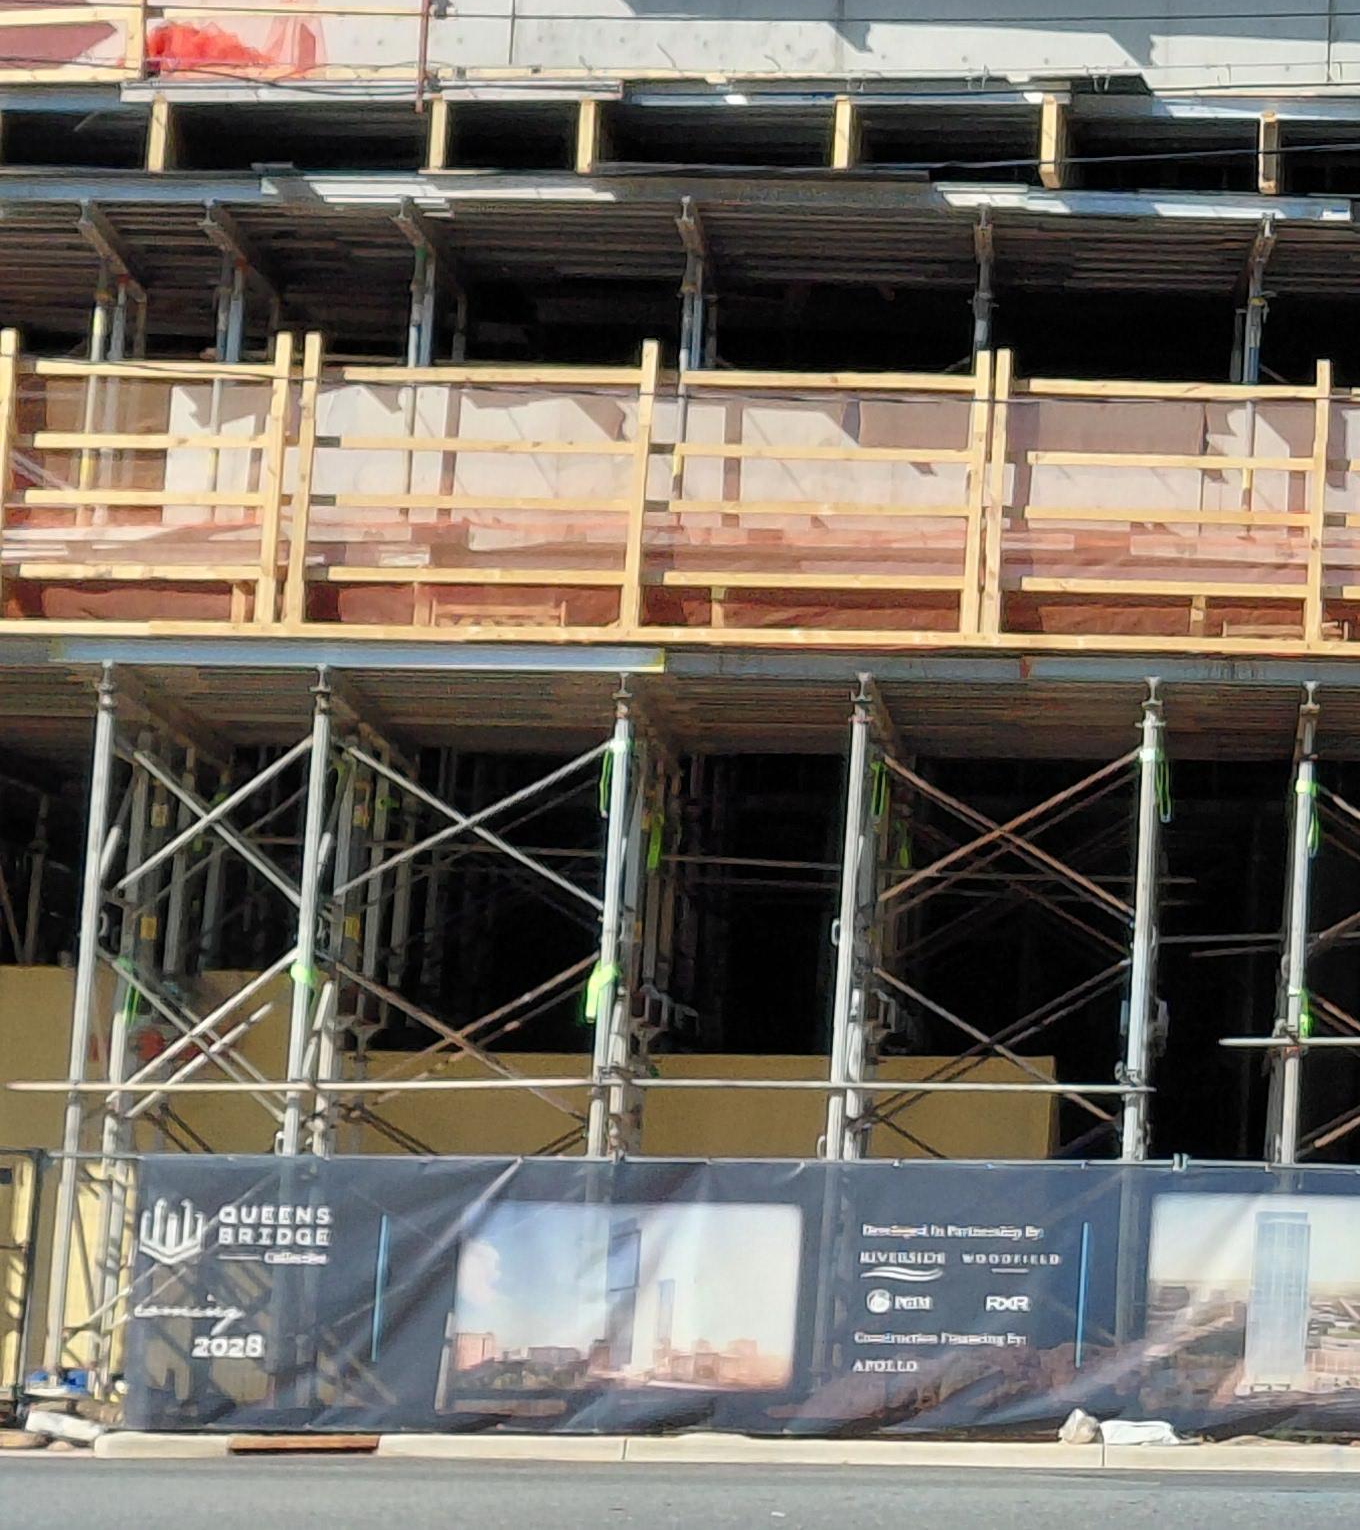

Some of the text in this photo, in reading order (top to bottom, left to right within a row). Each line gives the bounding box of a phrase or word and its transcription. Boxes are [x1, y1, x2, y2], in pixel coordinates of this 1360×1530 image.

[218, 1205, 332, 1225] QUEENS
[218, 1227, 331, 1246] BRIDGE
[860, 1251, 1061, 1265] RIVERSIDE WOODFIELD
[985, 1295, 1031, 1311] RXR
[134, 1293, 246, 1336] coming
[192, 1334, 265, 1358] 2028
[852, 1360, 918, 1373] APOLLO
